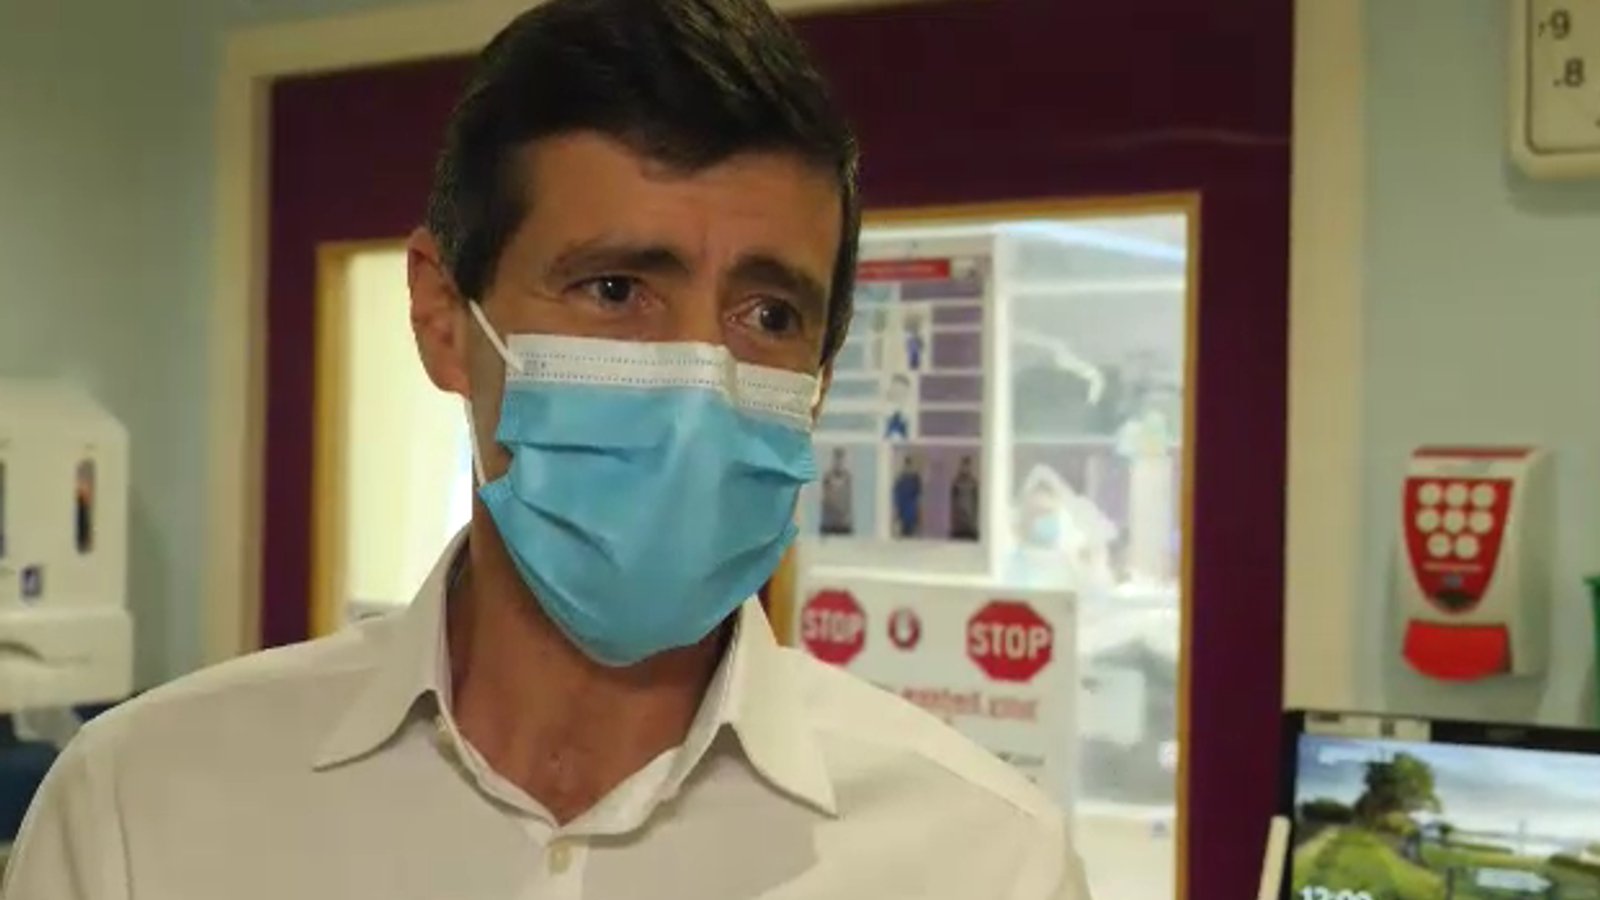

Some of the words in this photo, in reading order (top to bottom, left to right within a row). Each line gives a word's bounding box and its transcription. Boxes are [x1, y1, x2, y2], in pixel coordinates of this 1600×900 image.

[1550, 9, 1571, 40] 9
[1564, 57, 1585, 88] 8
[803, 608, 863, 643] STOP
[967, 623, 1052, 660] STOP
